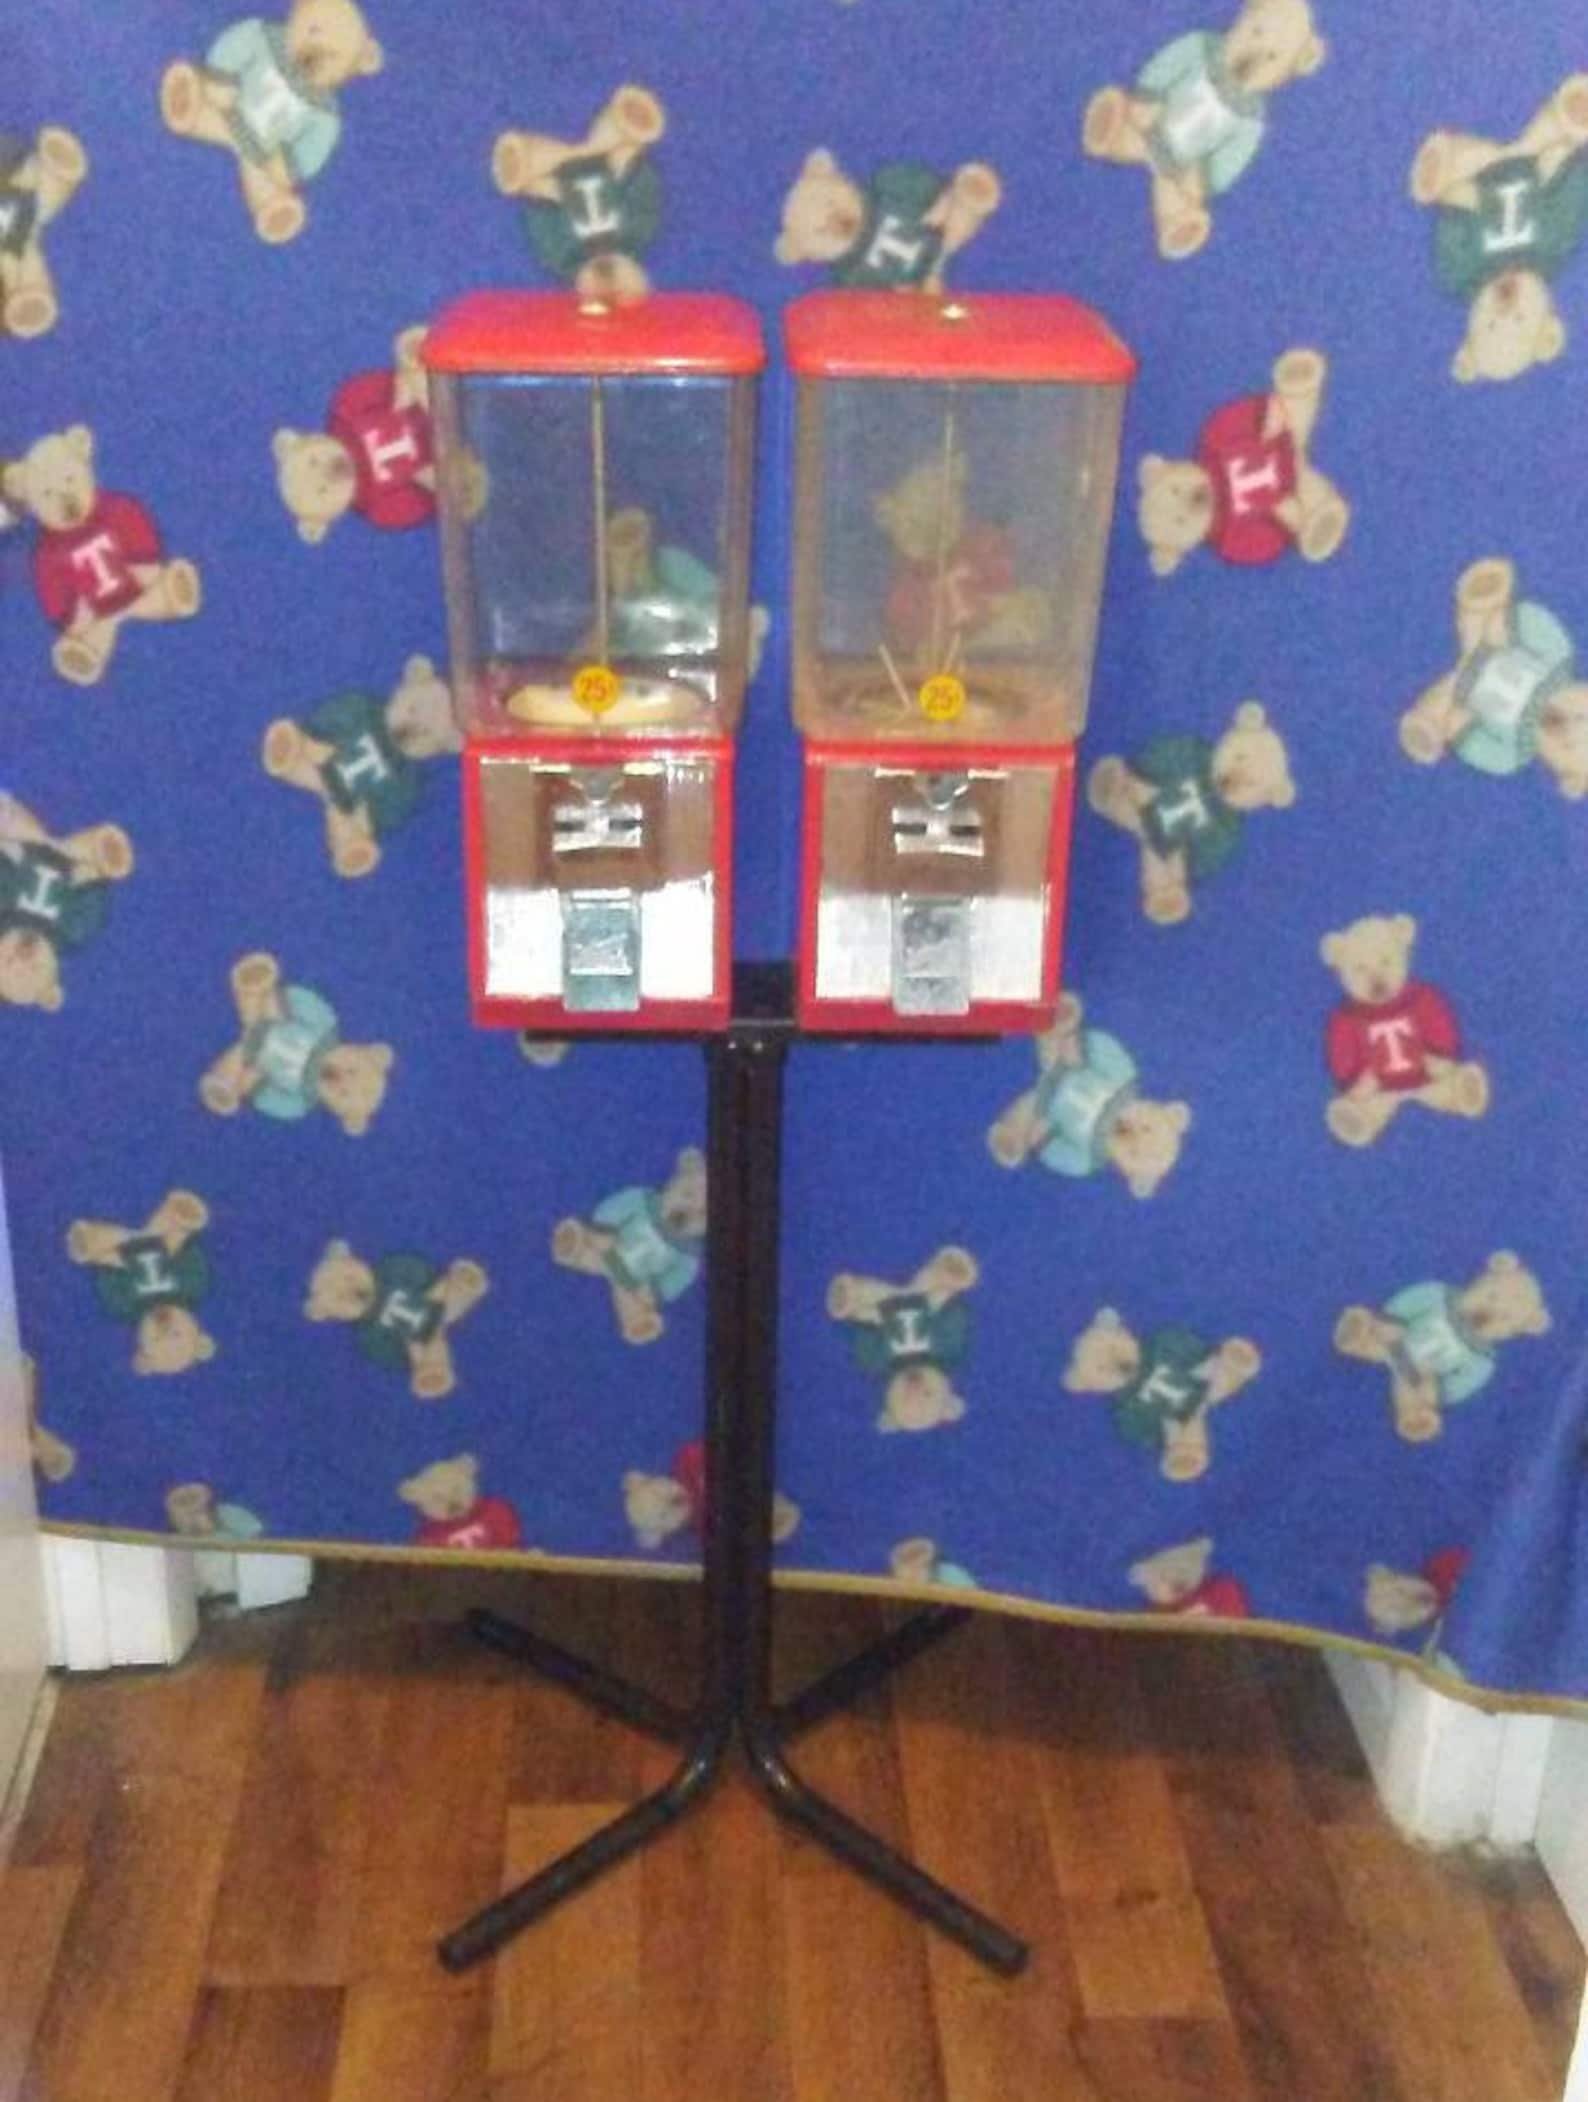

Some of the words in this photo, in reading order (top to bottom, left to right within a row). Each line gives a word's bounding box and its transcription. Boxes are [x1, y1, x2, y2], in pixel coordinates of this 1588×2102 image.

[363, 425, 418, 482] T
[1227, 456, 1281, 514] T
[72, 534, 120, 599] T
[1367, 1017, 1413, 1074] T
